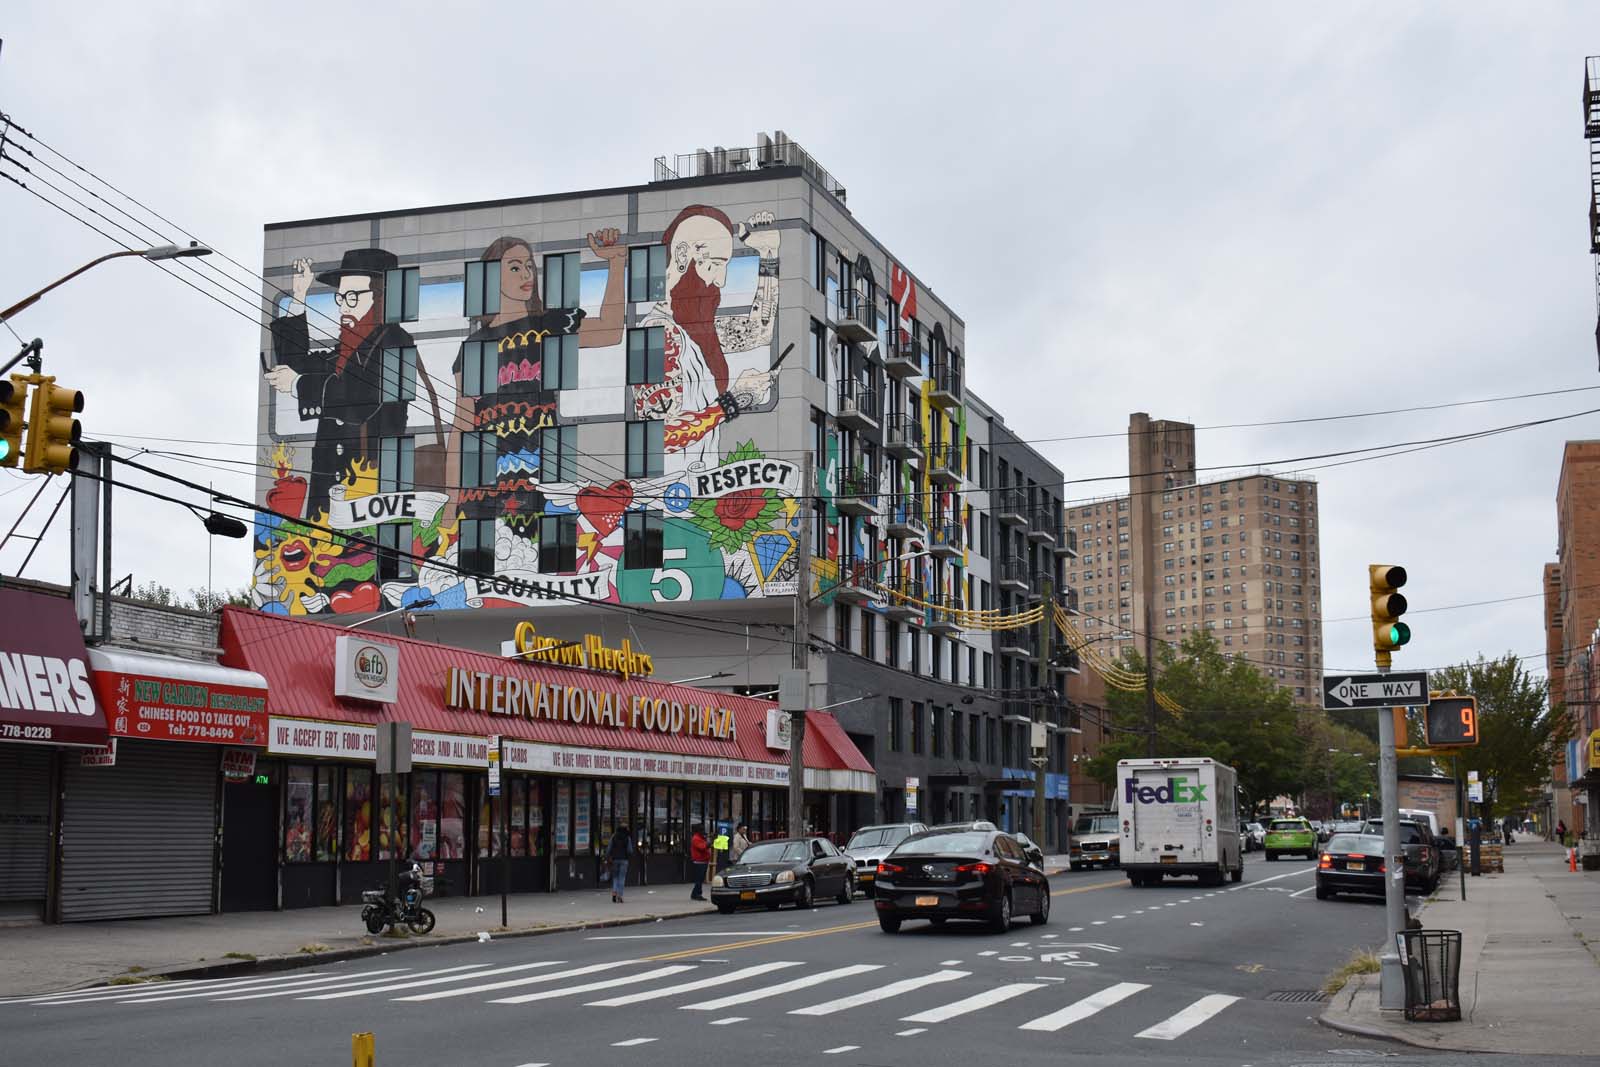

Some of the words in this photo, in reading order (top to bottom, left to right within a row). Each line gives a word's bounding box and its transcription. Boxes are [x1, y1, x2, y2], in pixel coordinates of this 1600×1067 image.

[697, 463, 792, 496] RESPECT
[826, 458, 837, 507] 4
[350, 494, 416, 523] LOVE
[476, 575, 600, 600] EQUALITY
[650, 548, 693, 602] 5
[134, 680, 161, 703] NEW
[163, 682, 208, 708] GARDEN
[1339, 684, 1369, 698] ONE
[1382, 682, 1414, 697] WAY
[139, 706, 174, 721] CHINESE
[176, 710, 200, 723] FOOD
[201, 712, 212, 724] TO
[213, 713, 233, 726] TAKE
[235, 715, 251, 728] OUT
[447, 667, 625, 727] INTERNATIONAL
[629, 695, 683, 733] FOOD
[686, 703, 736, 742] PLAZA
[168, 724, 186, 736] Tel:
[188, 726, 234, 739] 778-8496
[1460, 707, 1474, 737] 9
[277, 727, 289, 745] WE
[293, 728, 321, 748] ACCEPT
[325, 731, 339, 752] EBT,
[343, 733, 360, 750] FOOD
[363, 734, 377, 752] STA
[411, 738, 435, 756] CHECKS
[438, 740, 451, 757] AND
[454, 741, 463, 758] ALL
[467, 743, 487, 760] MAJOR
[255, 775, 269, 785] ATM
[1125, 777, 1208, 804] FedEx
